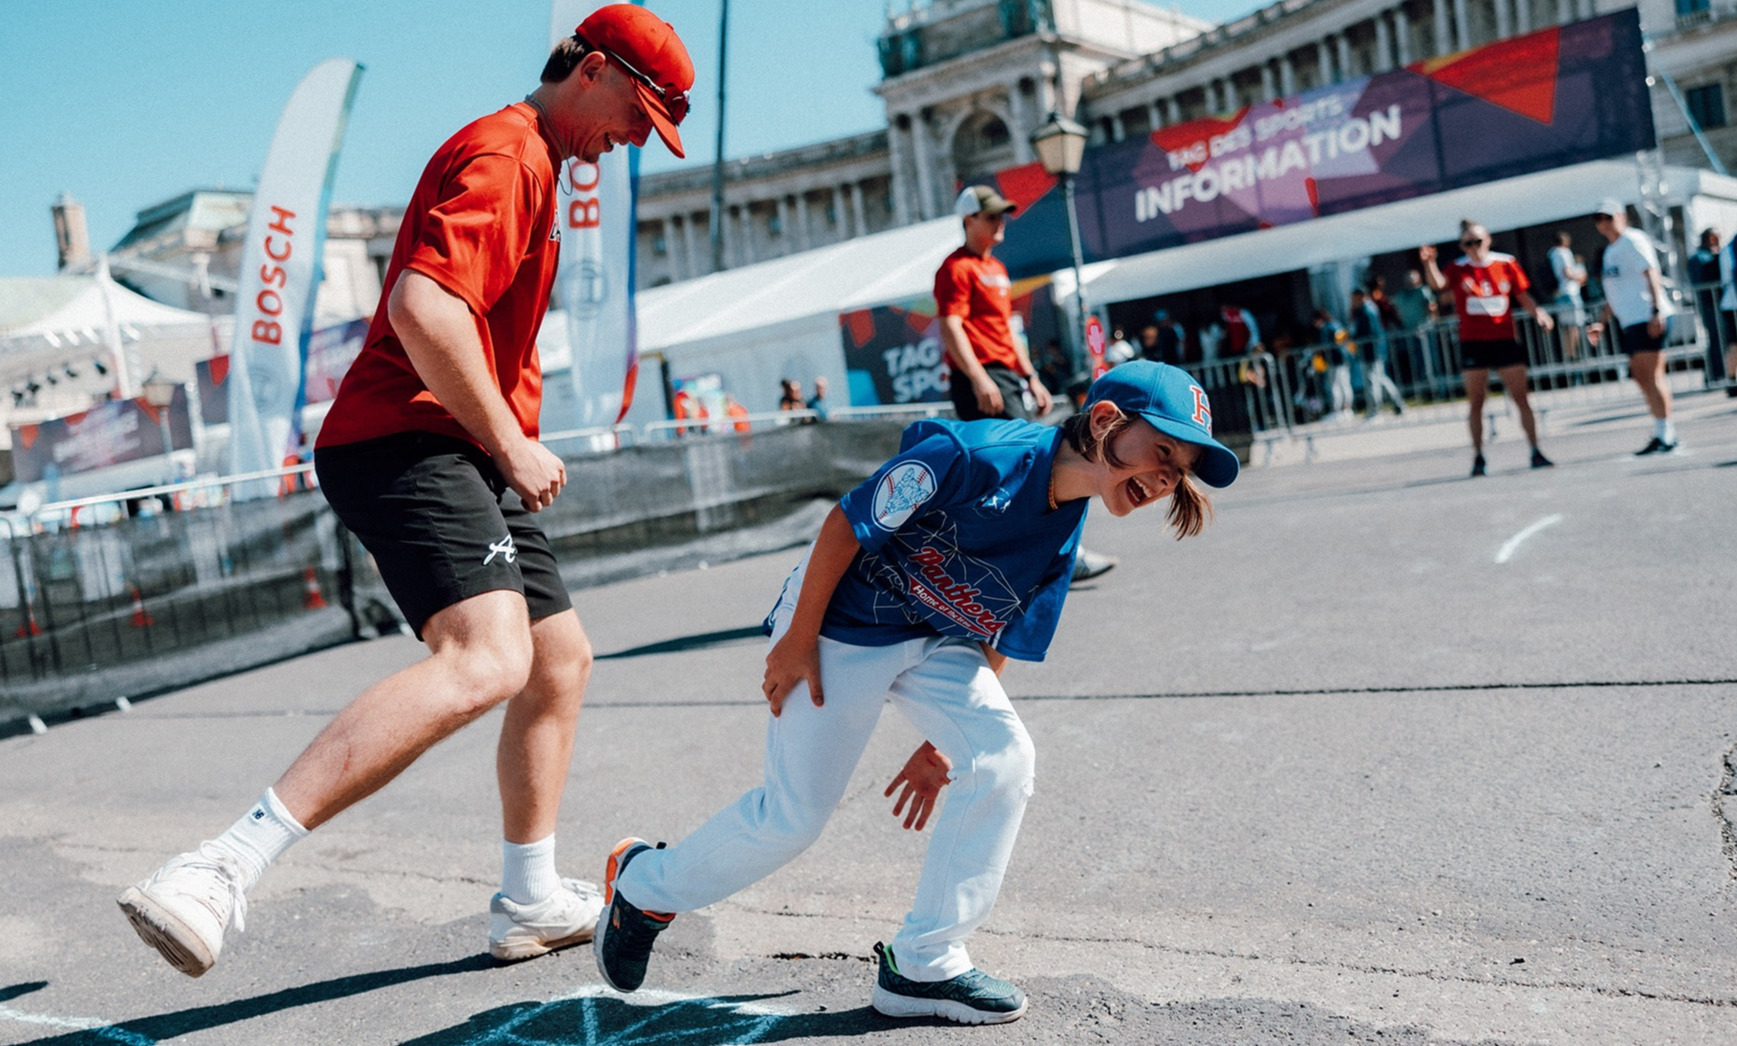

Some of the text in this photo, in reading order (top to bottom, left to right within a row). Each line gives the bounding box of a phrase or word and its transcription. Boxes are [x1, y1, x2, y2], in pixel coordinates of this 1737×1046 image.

[1135, 104, 1401, 222] INFORMATION
[1166, 94, 1343, 170] TAG DES SPORTS
[252, 205, 296, 345] BOSCH
[882, 336, 940, 377] TAG
[907, 546, 1008, 634] Panthers
[912, 585, 939, 606] Home
